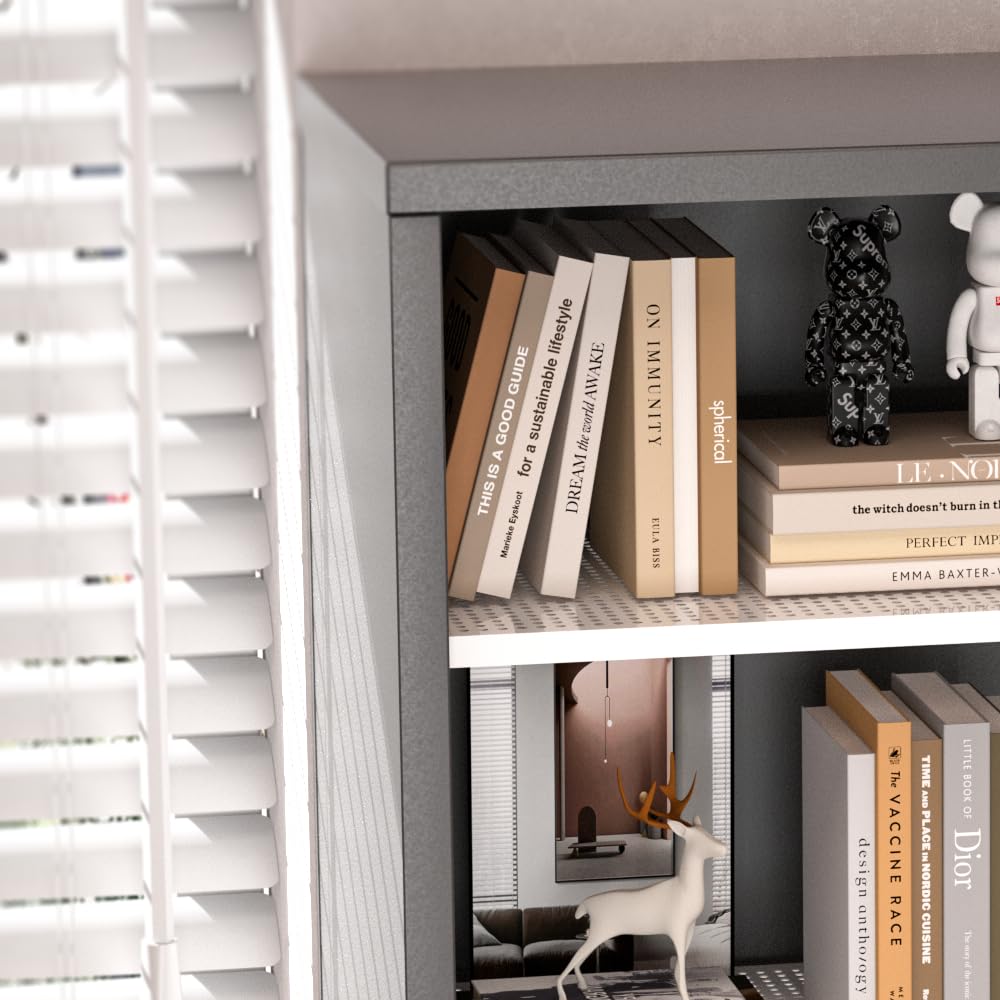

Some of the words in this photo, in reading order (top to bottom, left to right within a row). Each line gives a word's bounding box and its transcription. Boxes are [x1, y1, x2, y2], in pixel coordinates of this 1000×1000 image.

[547, 298, 573, 355] lifestyle
[647, 304, 661, 329] ON
[509, 346, 529, 395] GUIDE
[529, 357, 558, 442] sustainable
[648, 342, 663, 446] IMMUNITY
[496, 398, 515, 446] GOOD
[709, 400, 732, 464] spherical
[492, 450, 504, 461] A
[527, 445, 537, 454] a
[488, 464, 500, 483] IS
[517, 457, 534, 477] for
[897, 462, 931, 484] LE
[478, 487, 499, 517] THIS
[853, 505, 870, 515] the
[874, 504, 904, 515] witch
[906, 502, 948, 513] doesn't
[951, 501, 976, 511] burn
[979, 501, 991, 510] in
[501, 526, 515, 559] Marieke
[509, 491, 523, 525] Eyskoot
[652, 518, 660, 544] EULA
[906, 535, 967, 549] PERFECT
[652, 548, 660, 568] BISS
[892, 568, 932, 582] EMMA
[890, 771, 900, 788] The
[890, 795, 902, 883] VACCINE
[855, 838, 870, 897] design
[954, 828, 982, 890] Dior
[890, 896, 902, 946] RACE
[856, 906, 870, 994] anthology
